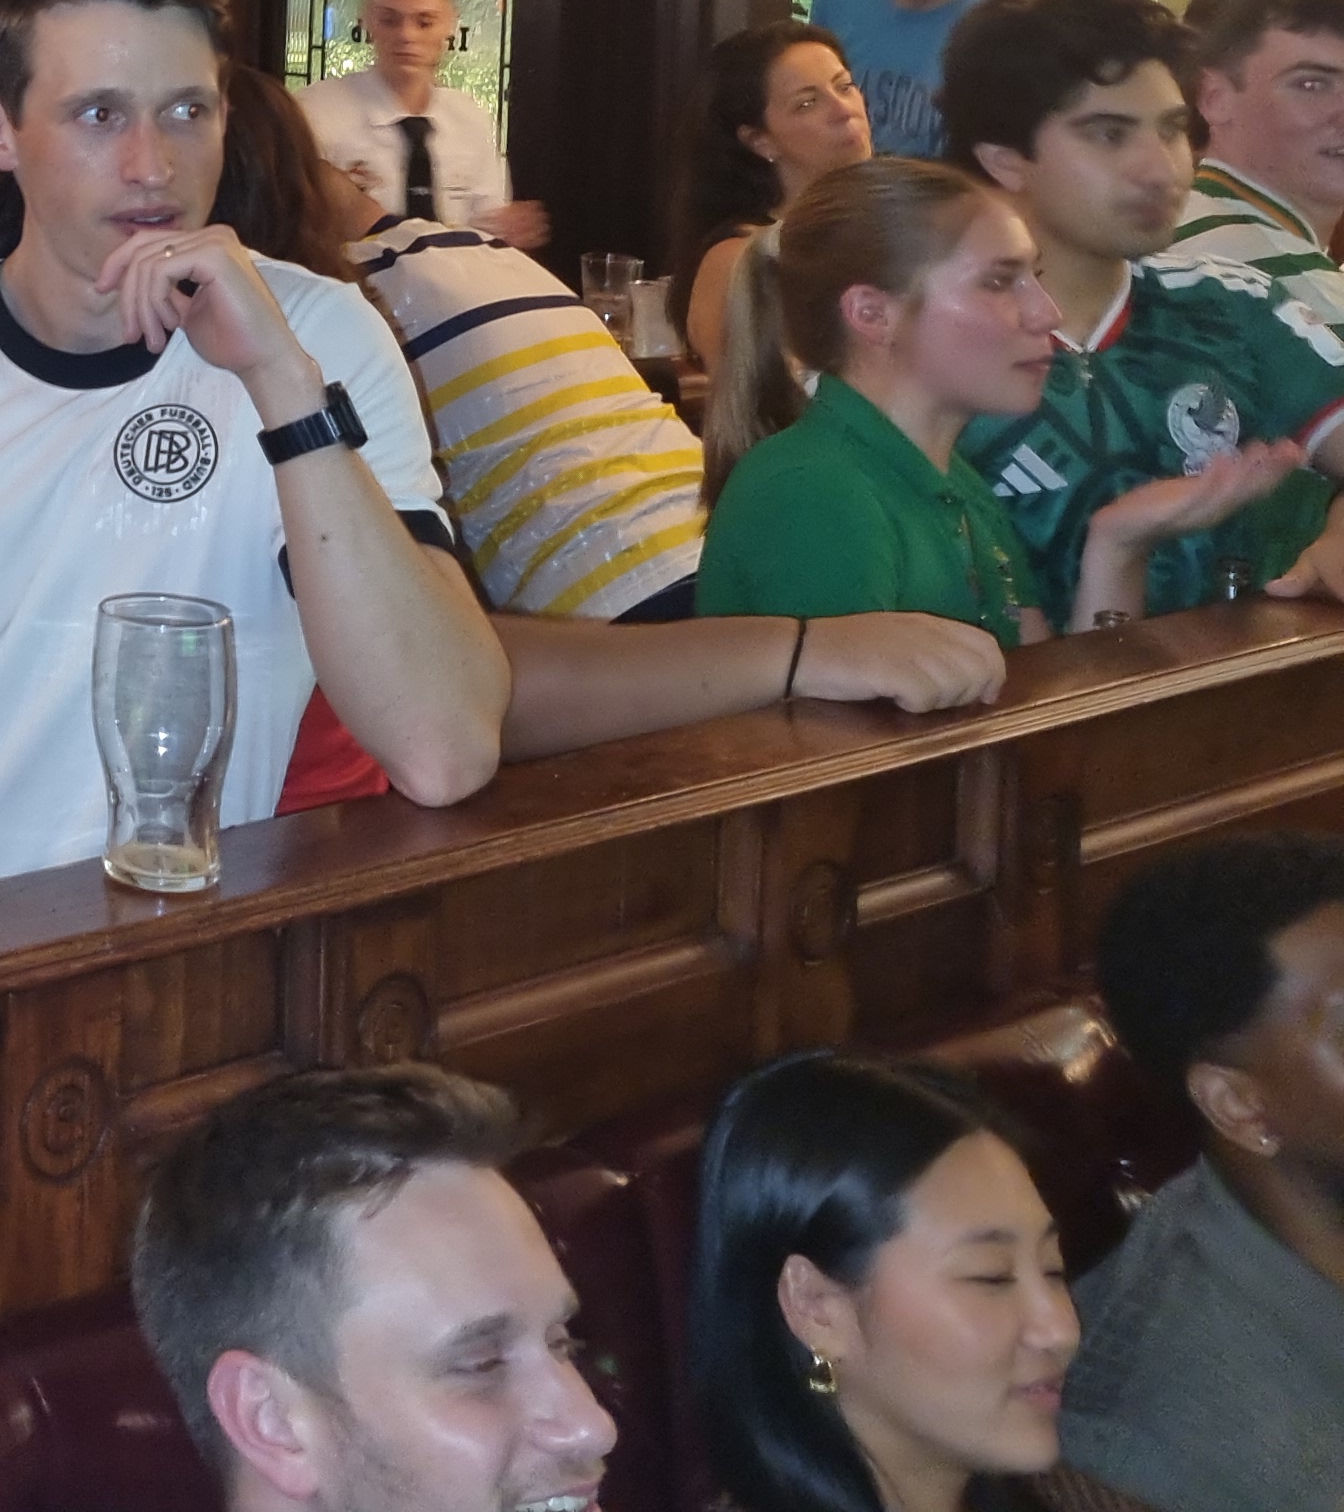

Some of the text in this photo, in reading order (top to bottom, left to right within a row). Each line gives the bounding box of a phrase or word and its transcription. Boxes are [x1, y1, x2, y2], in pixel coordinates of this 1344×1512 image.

[119, 408, 212, 490] DEUTSCHER FUSSBALL BUND
[151, 486, 173, 498] 125
